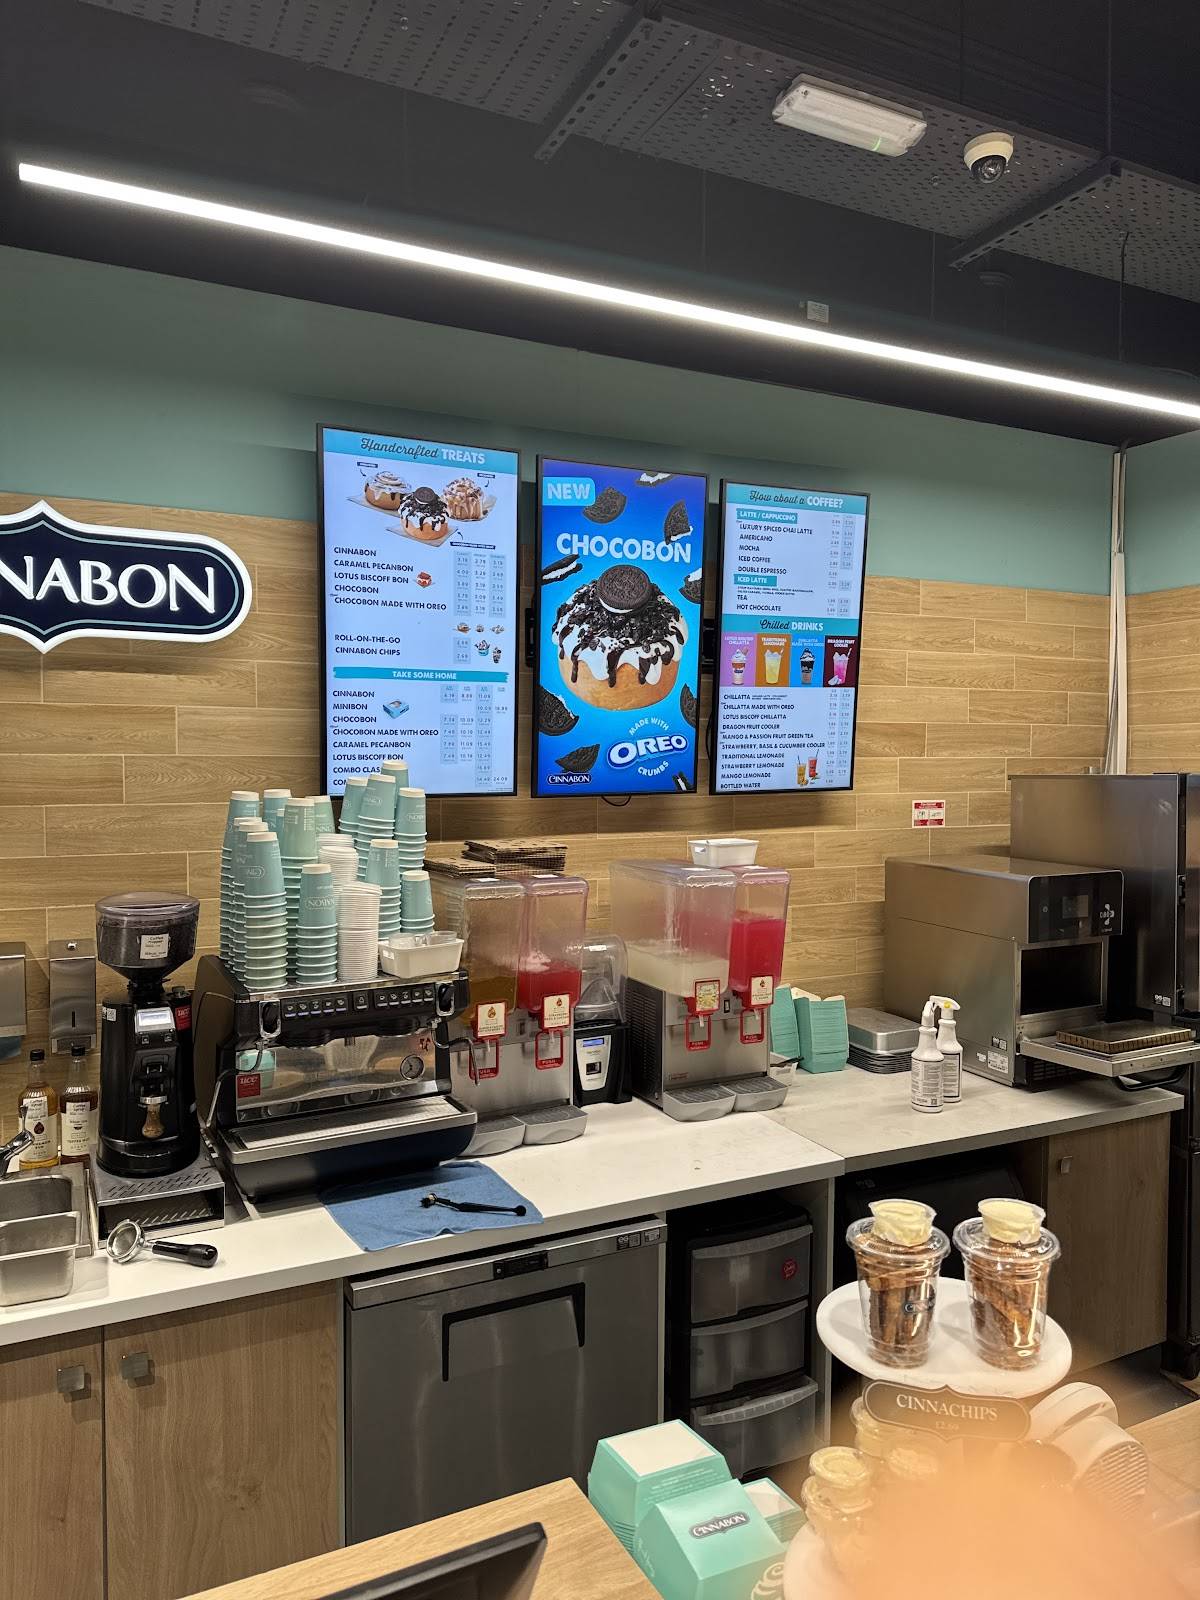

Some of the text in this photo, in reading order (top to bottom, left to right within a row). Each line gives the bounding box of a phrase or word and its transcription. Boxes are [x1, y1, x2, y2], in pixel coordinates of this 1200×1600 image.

[360, 437, 486, 464] Handcrafted TREATS
[547, 483, 591, 500] NEW
[749, 490, 771, 502] How
[773, 493, 798, 504] about
[807, 496, 844, 509] COFFEE?
[761, 512, 796, 521] CAPPUCCINO
[763, 525, 782, 533] SPICED
[740, 534, 773, 542] AMERICANO
[334, 547, 377, 557] CINNABON
[556, 532, 692, 564] CHOCOBON
[334, 560, 414, 572] CARAMEL PECANBON
[334, 572, 409, 584] LOTUS BISCOFF BON
[334, 584, 379, 594] CHOCOBON
[334, 597, 379, 606] CHOCOBON
[381, 600, 404, 608] MADE
[759, 619, 824, 632] Chilled DRINKS
[334, 634, 401, 644] ROLL-ON-THE-GO
[335, 647, 401, 656] CINNABON CHIPS
[392, 670, 457, 680] TAKE SOME HOME
[332, 690, 375, 698] CINNABON
[628, 717, 670, 736] MADE WITH
[609, 735, 687, 765] OREO
[332, 766, 381, 774] COMBO CLAS
[638, 760, 669, 776] CRUMBS
[548, 775, 590, 784] CINNABON
[896, 1393, 998, 1421] CINNACHIPS
[692, 1513, 747, 1538] CINNABON
